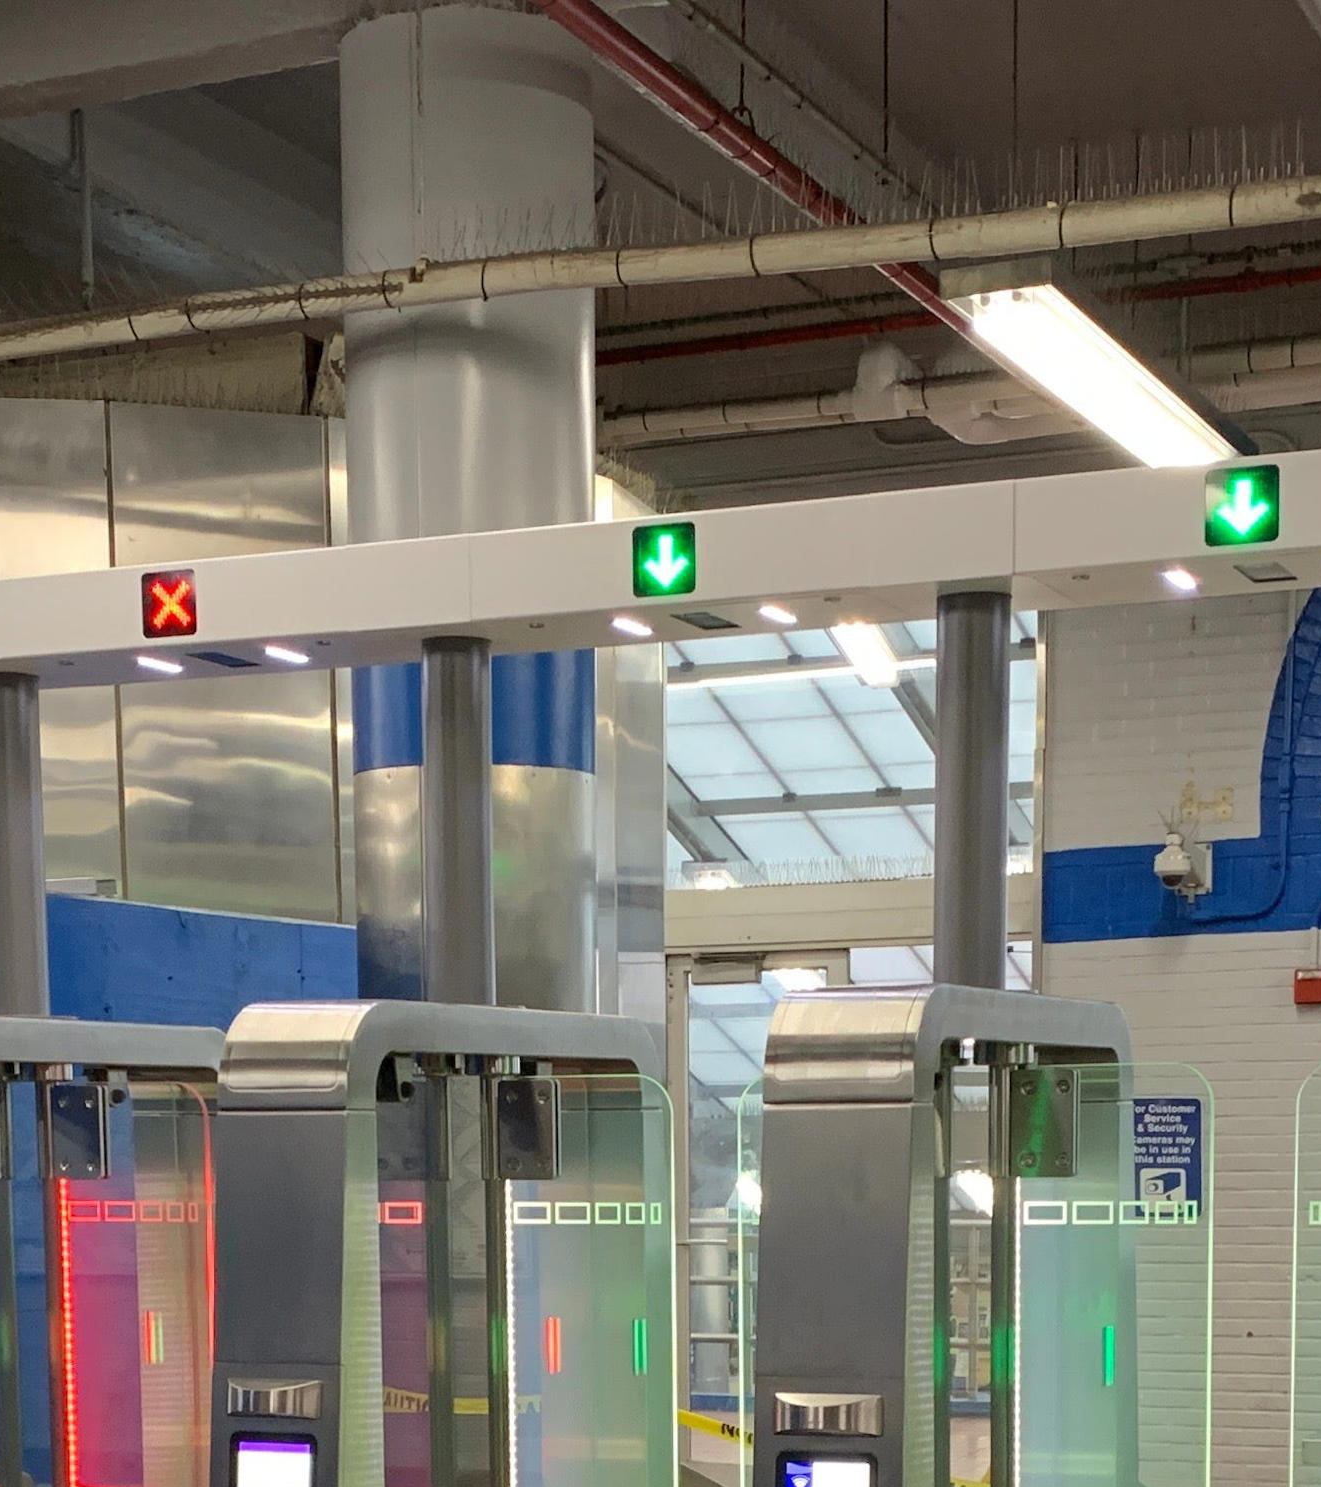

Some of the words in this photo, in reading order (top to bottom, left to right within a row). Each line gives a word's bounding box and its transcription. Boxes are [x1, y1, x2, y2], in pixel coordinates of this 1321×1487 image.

[1148, 1104, 1197, 1113] Customer
[1143, 1113, 1182, 1123] Service
[1137, 1124, 1144, 1132] &
[1147, 1123, 1189, 1134] Security
[1176, 1136, 1196, 1146] may
[1149, 1145, 1159, 1153] in
[1182, 1145, 1191, 1153] in
[1134, 1155, 1154, 1164] this
[1156, 1155, 1191, 1164] station
